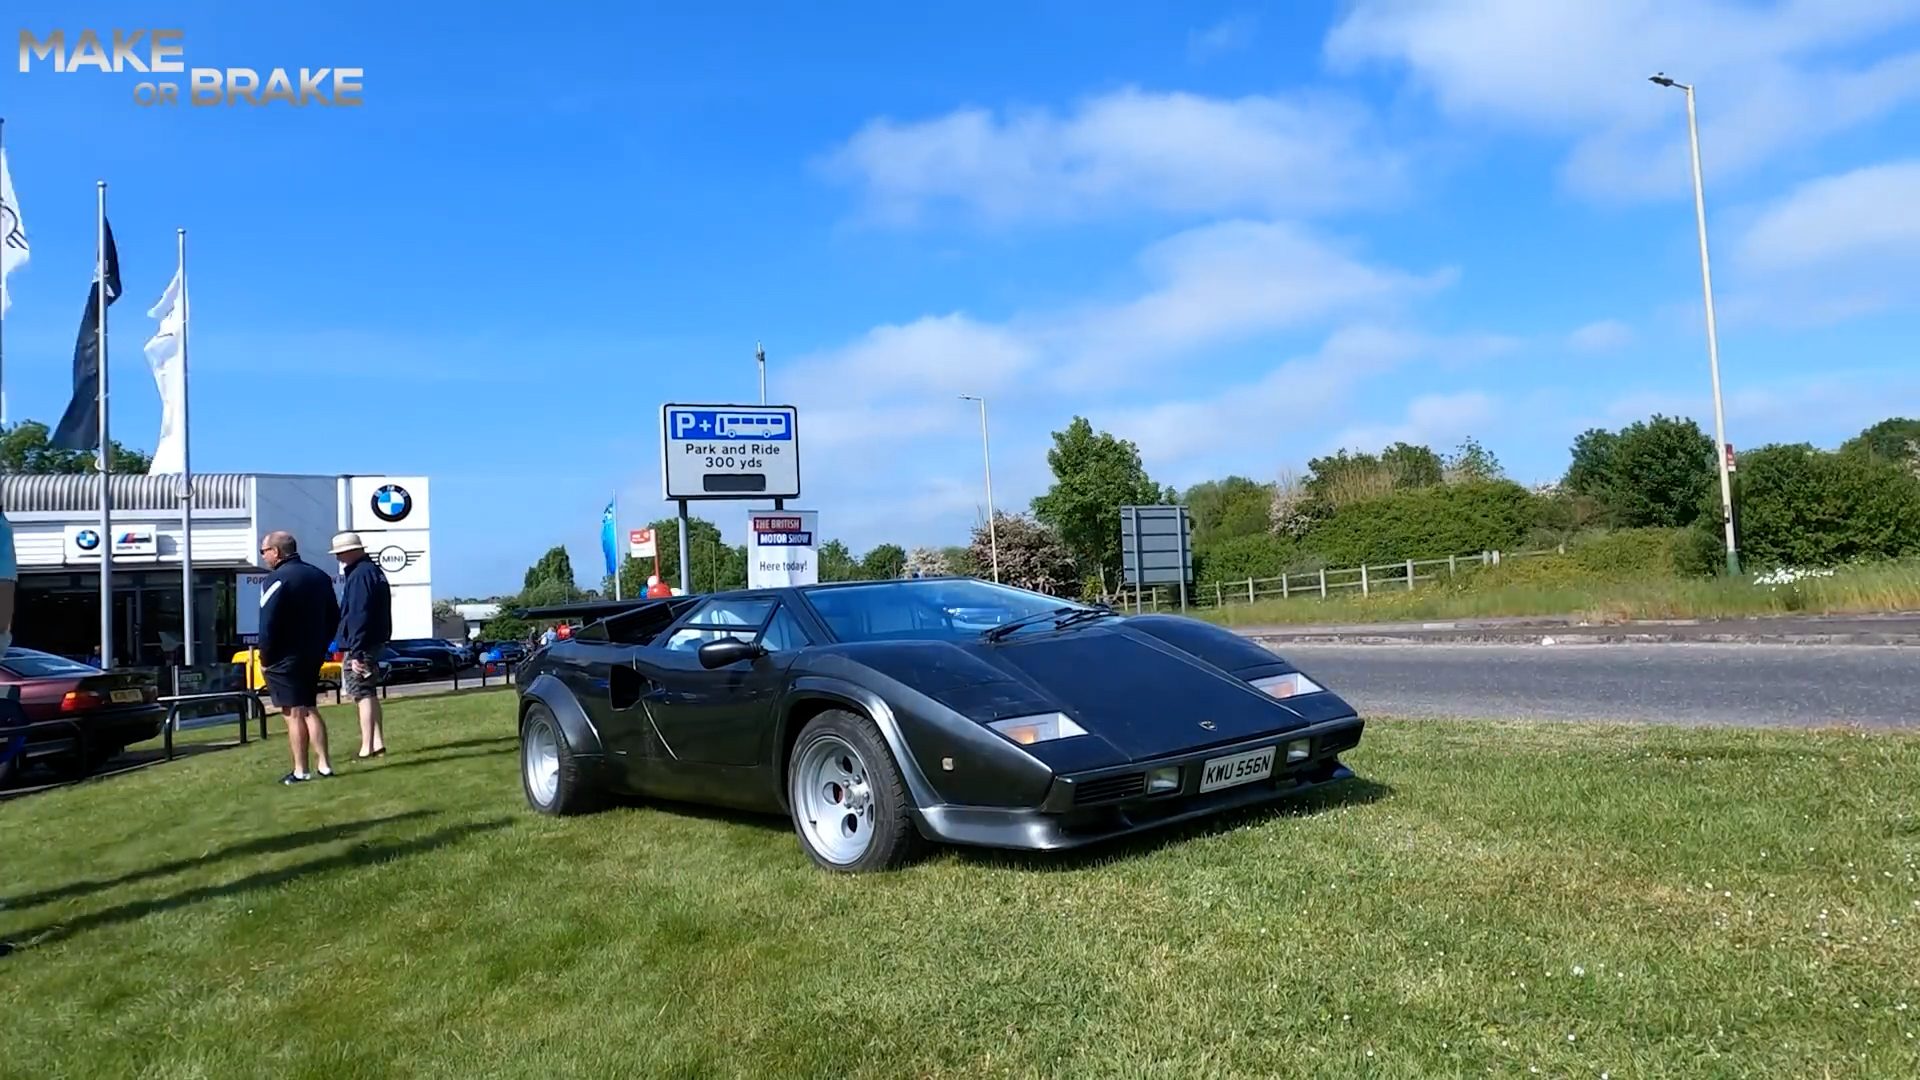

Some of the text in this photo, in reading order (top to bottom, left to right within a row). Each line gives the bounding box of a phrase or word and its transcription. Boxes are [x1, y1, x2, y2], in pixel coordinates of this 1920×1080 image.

[685, 443, 780, 455] Park and Ride
[705, 456, 763, 470] 300 yds
[754, 519, 800, 529] THE BRITISH
[760, 533, 810, 544] MOTOR SHOW
[381, 555, 404, 564] MINI
[759, 560, 808, 573] Here today!
[1205, 754, 1271, 785] KWU 556N
